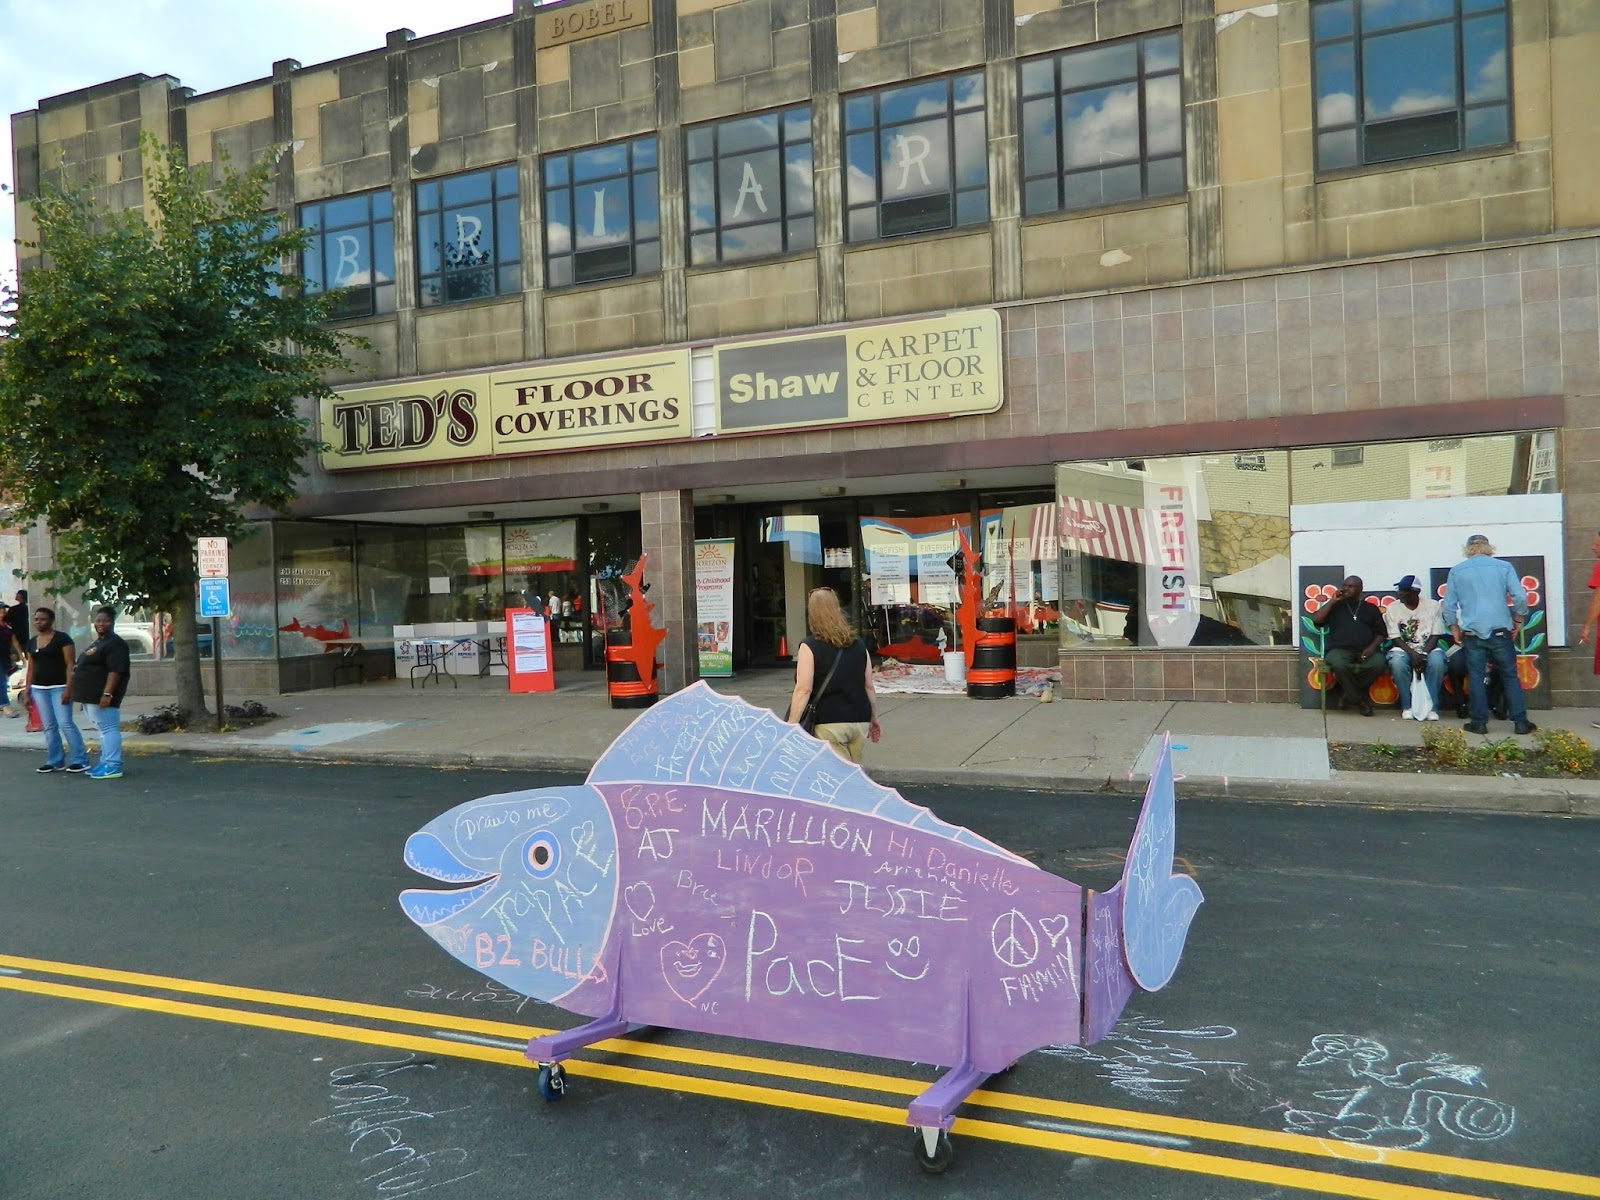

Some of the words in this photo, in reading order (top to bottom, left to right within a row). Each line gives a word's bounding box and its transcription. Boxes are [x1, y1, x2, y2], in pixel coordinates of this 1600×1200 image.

[551, 0, 633, 39] BOBEL
[855, 326, 983, 363] CARPET
[516, 373, 654, 406] FLOOR
[729, 371, 839, 404] Shaw
[856, 368, 877, 388] &
[887, 355, 985, 386] FLOOR
[857, 381, 986, 408] CENTER
[333, 389, 478, 456] TED'S
[495, 397, 679, 437] COVERINGS
[1160, 486, 1186, 610] FIREFISH
[701, 797, 873, 857] MARILLION
[888, 830, 916, 859] Hi
